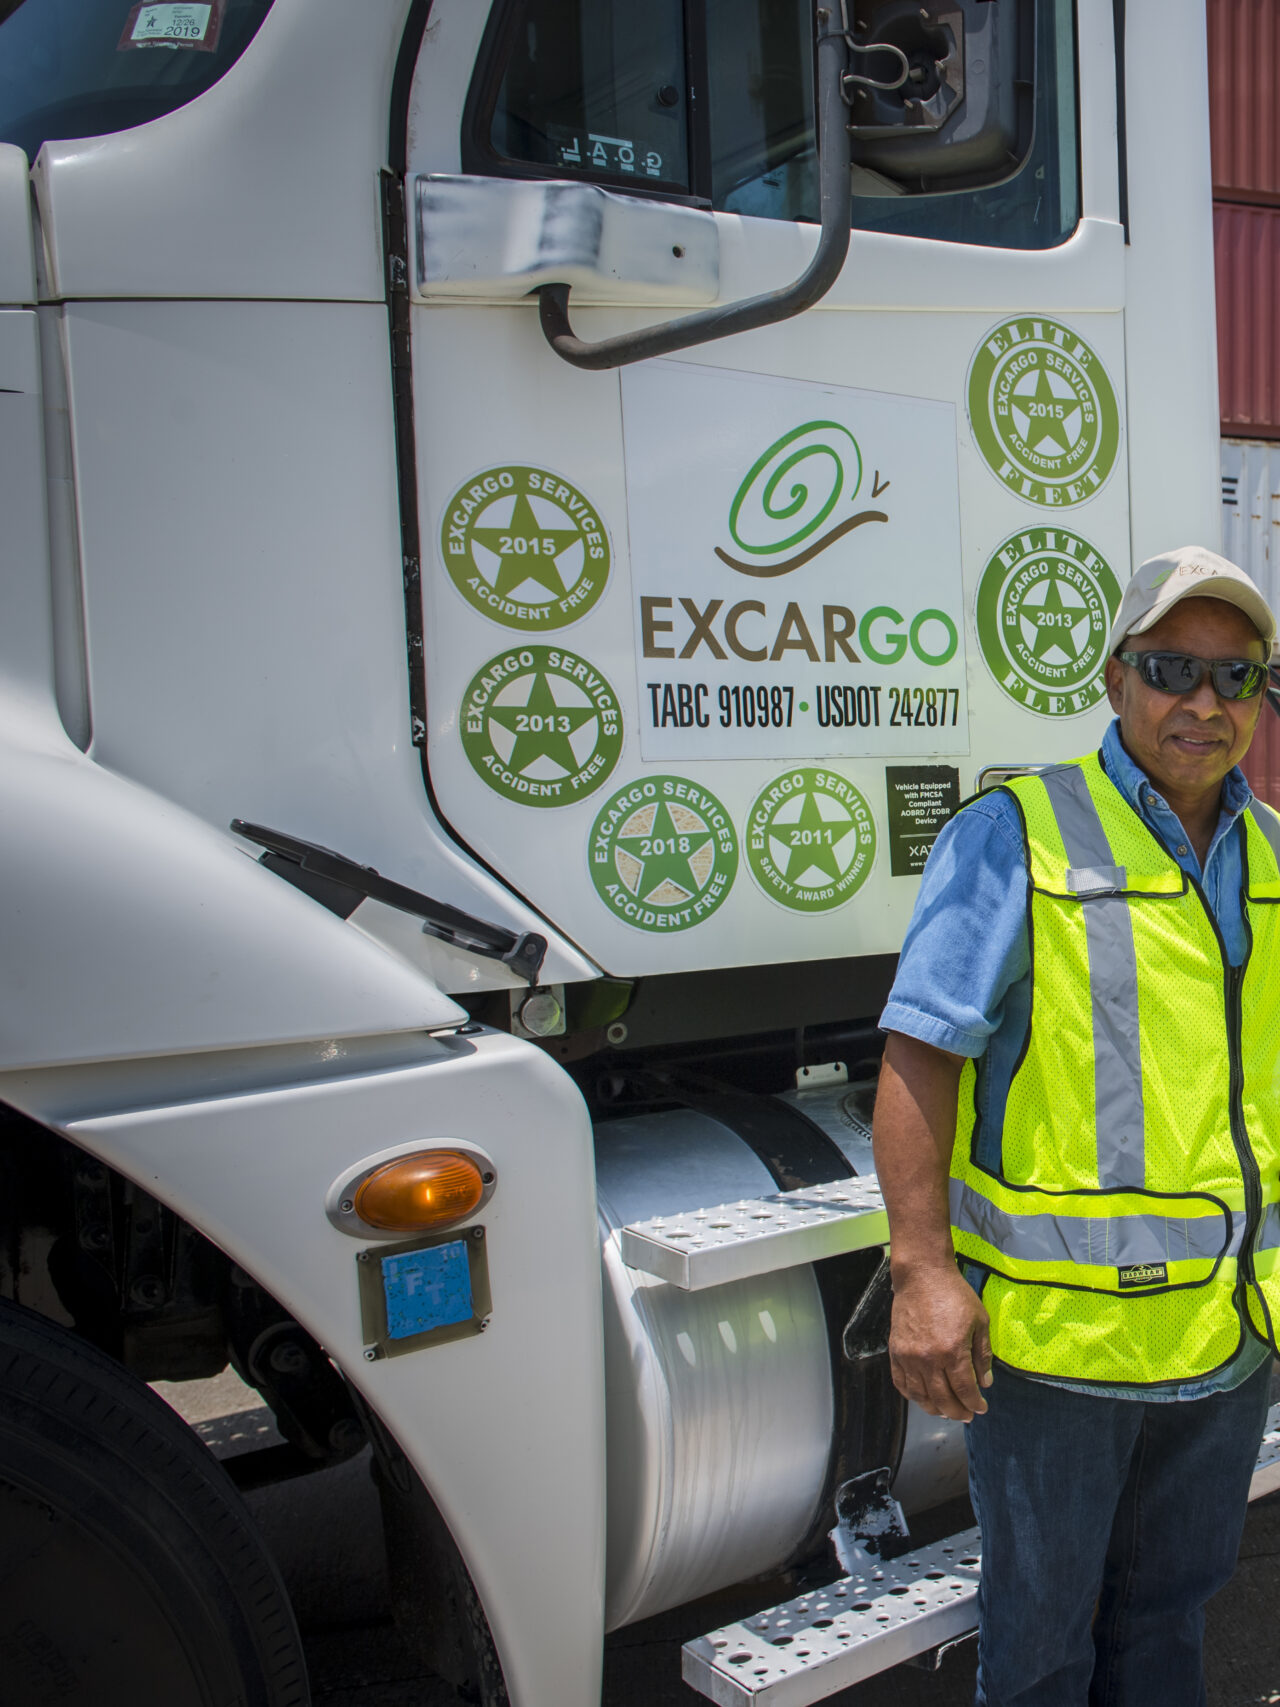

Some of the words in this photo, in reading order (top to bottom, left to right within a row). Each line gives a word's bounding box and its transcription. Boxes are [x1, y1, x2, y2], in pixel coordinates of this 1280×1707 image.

[164, 26, 200, 37] 2019
[986, 321, 1093, 369] ELITE
[997, 352, 1038, 416] EXCARGO
[1046, 353, 1095, 424] SERVICES
[1028, 402, 1064, 419] 2015
[1009, 433, 1061, 469] ACCIDENT
[1066, 437, 1088, 464] FREE
[998, 460, 1102, 505] FLEET
[449, 472, 514, 555] EXCARGO
[528, 473, 604, 559] SERVICES
[499, 536, 556, 555] 2015
[997, 532, 1104, 577] ELITE
[466, 577, 551, 620] ACCIDENT
[559, 577, 594, 613] FREE
[1006, 561, 1049, 626] EXCARGO
[1057, 562, 1103, 631] SERVICES
[640, 596, 959, 666] EXCARGO
[1036, 612, 1073, 628] 2013
[1015, 643, 1067, 678] ACCIDENT
[1073, 645, 1096, 673] FREE
[467, 651, 534, 733] EXCARGO
[548, 652, 618, 736] SERVICES
[647, 682, 710, 728] TABC
[719, 685, 795, 728] 910987
[816, 685, 882, 728] USDOT
[888, 687, 960, 727] 242877
[1002, 669, 1107, 714] FLEET
[515, 714, 571, 733] 2013
[482, 755, 562, 796] ACCIDENT
[570, 754, 606, 789] FREE
[895, 783, 919, 791] Vehicle
[920, 781, 951, 791] Equipped
[595, 783, 656, 863] EXCARGO
[663, 782, 733, 854] SERVICES
[752, 774, 804, 849] EXCARGO
[815, 773, 872, 845] SERVICES
[908, 800, 942, 808] Compliant
[640, 837, 691, 856] 2018
[790, 829, 833, 846] 2011
[605, 883, 692, 927] ACCIDENT
[693, 872, 728, 916] FREE
[760, 857, 794, 895] SAFETY
[795, 888, 835, 902] AWARD
[836, 852, 866, 892] WINNER
